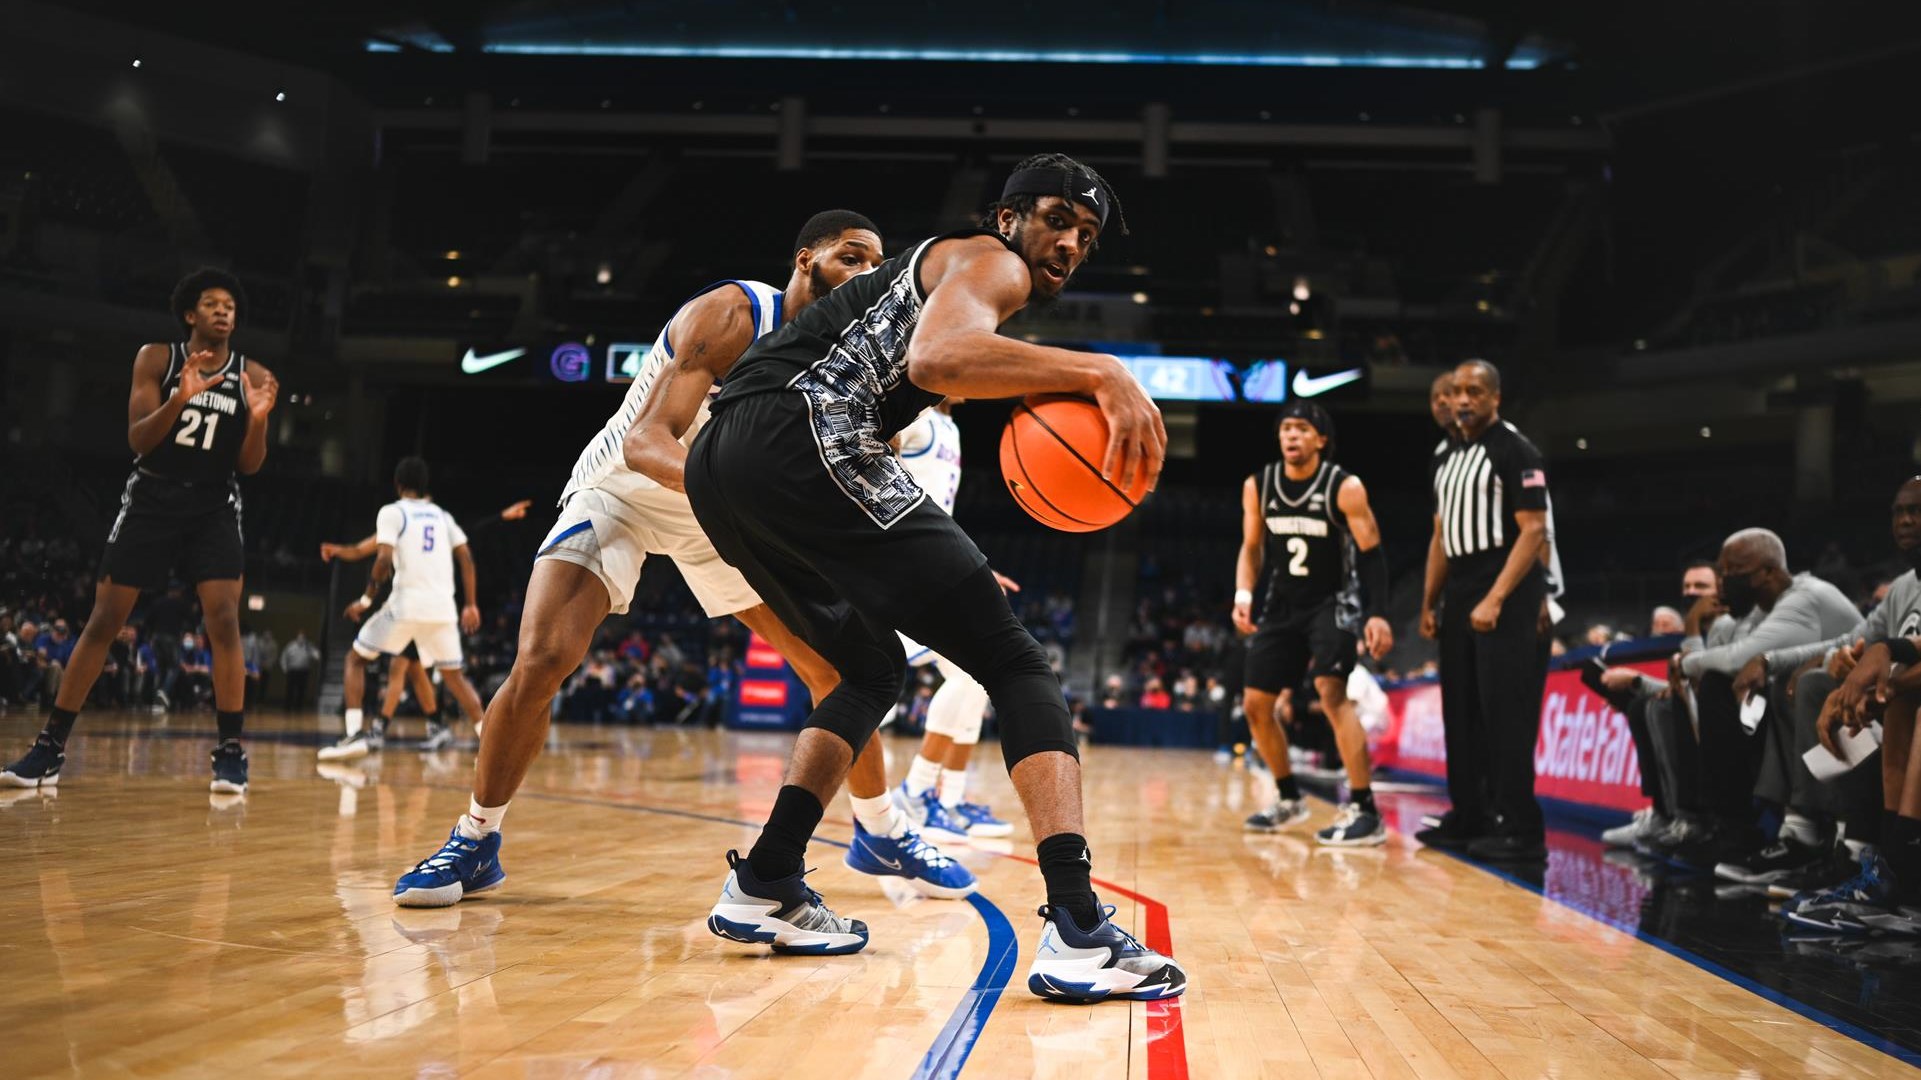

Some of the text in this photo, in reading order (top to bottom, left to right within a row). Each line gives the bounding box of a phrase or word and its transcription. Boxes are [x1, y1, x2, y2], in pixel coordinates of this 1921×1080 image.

[175, 408, 219, 450] 21
[422, 525, 435, 553] 5
[1286, 537, 1309, 576] 2
